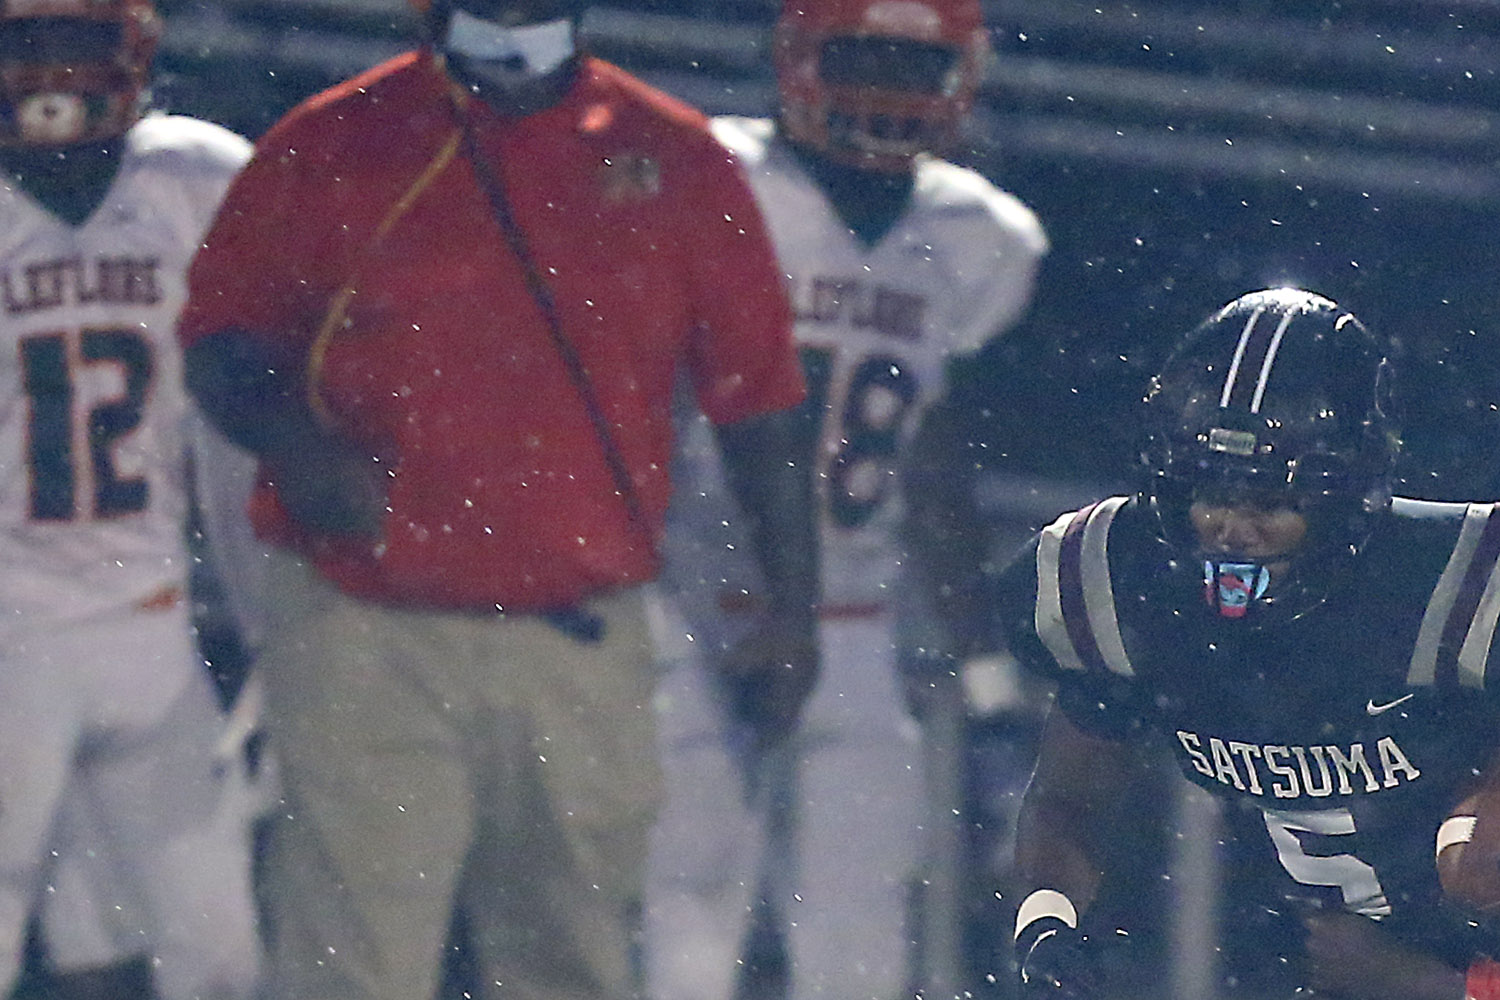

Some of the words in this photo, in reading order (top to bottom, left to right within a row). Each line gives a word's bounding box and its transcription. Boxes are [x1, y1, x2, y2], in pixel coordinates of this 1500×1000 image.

[18, 328, 157, 520] 12
[1176, 729, 1422, 798] SATSUMA
[1263, 807, 1393, 921] 5
